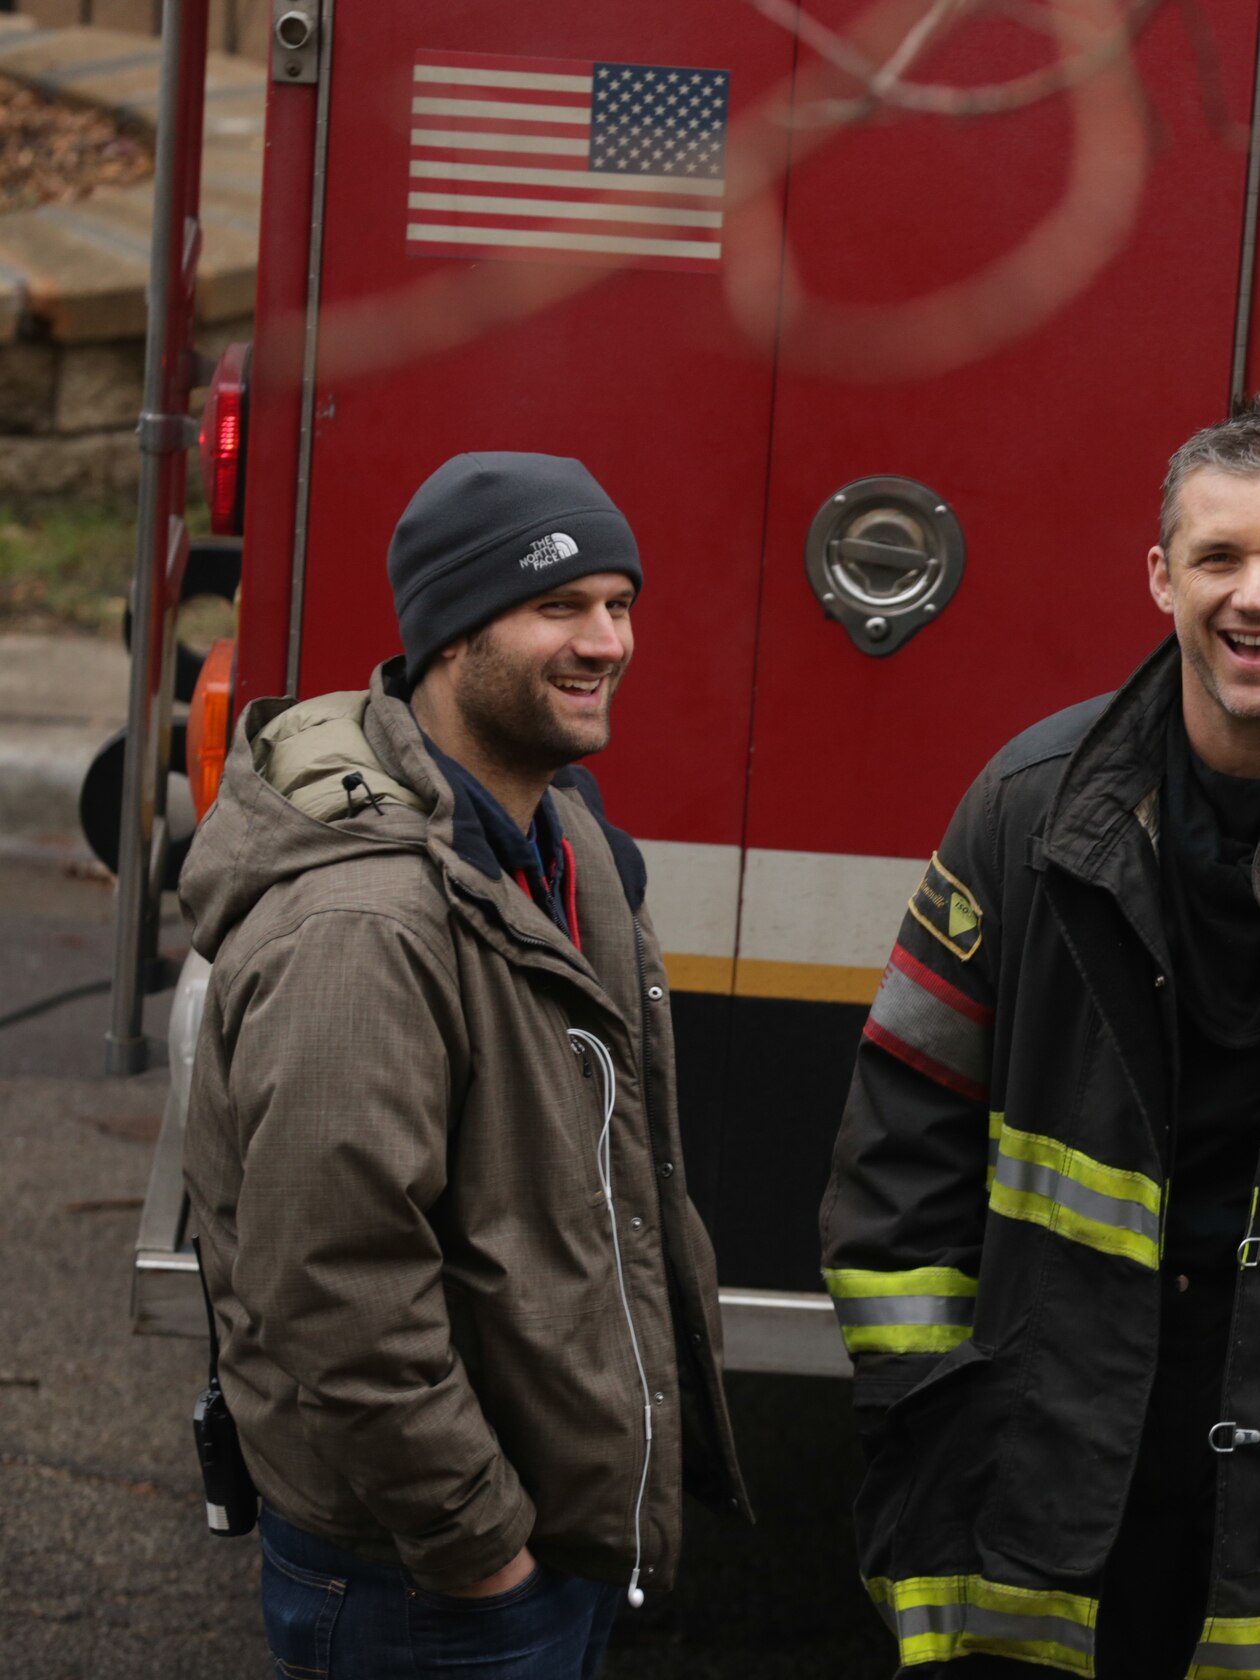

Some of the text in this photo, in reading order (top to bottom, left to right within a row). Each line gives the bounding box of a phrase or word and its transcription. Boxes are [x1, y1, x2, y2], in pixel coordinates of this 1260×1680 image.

[529, 535, 552, 550] THE
[519, 543, 558, 569] NORTH
[533, 552, 560, 571] FACE
